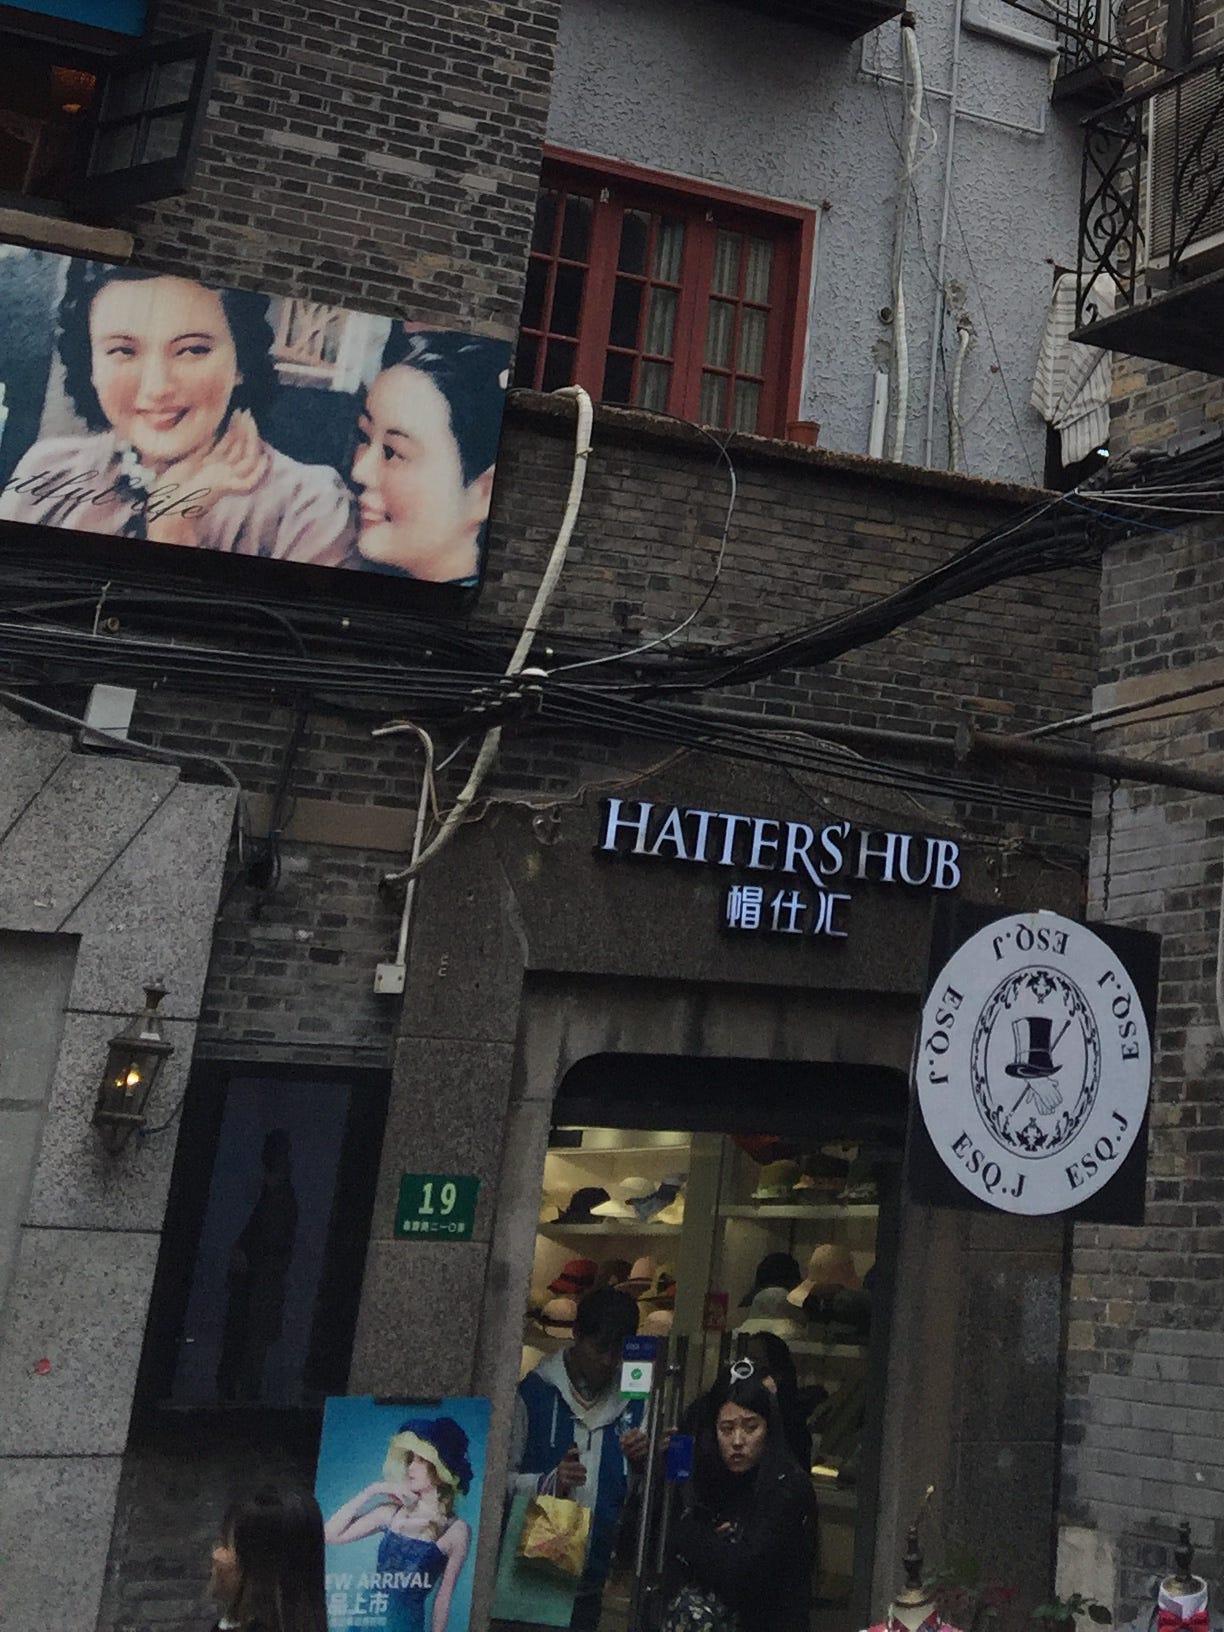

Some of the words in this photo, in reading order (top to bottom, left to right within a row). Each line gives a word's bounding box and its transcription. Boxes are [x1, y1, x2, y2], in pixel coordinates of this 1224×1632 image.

[131, 483, 212, 523] life
[601, 798, 850, 887] HATTERS'
[857, 830, 961, 889] HUB
[727, 885, 851, 937] 帽仕汇
[992, 923, 1071, 961] ESQ.J
[925, 986, 964, 1085] ESQ.J
[1097, 970, 1140, 1061] ESQ.J
[951, 1131, 1026, 1197] ESQ.J
[1065, 1110, 1129, 1190] ESQ.J
[418, 1182, 456, 1215] 19
[325, 1572, 352, 1590] EW
[358, 1571, 432, 1589] ARRIVAL
[327, 1591, 389, 1615] 品上市
